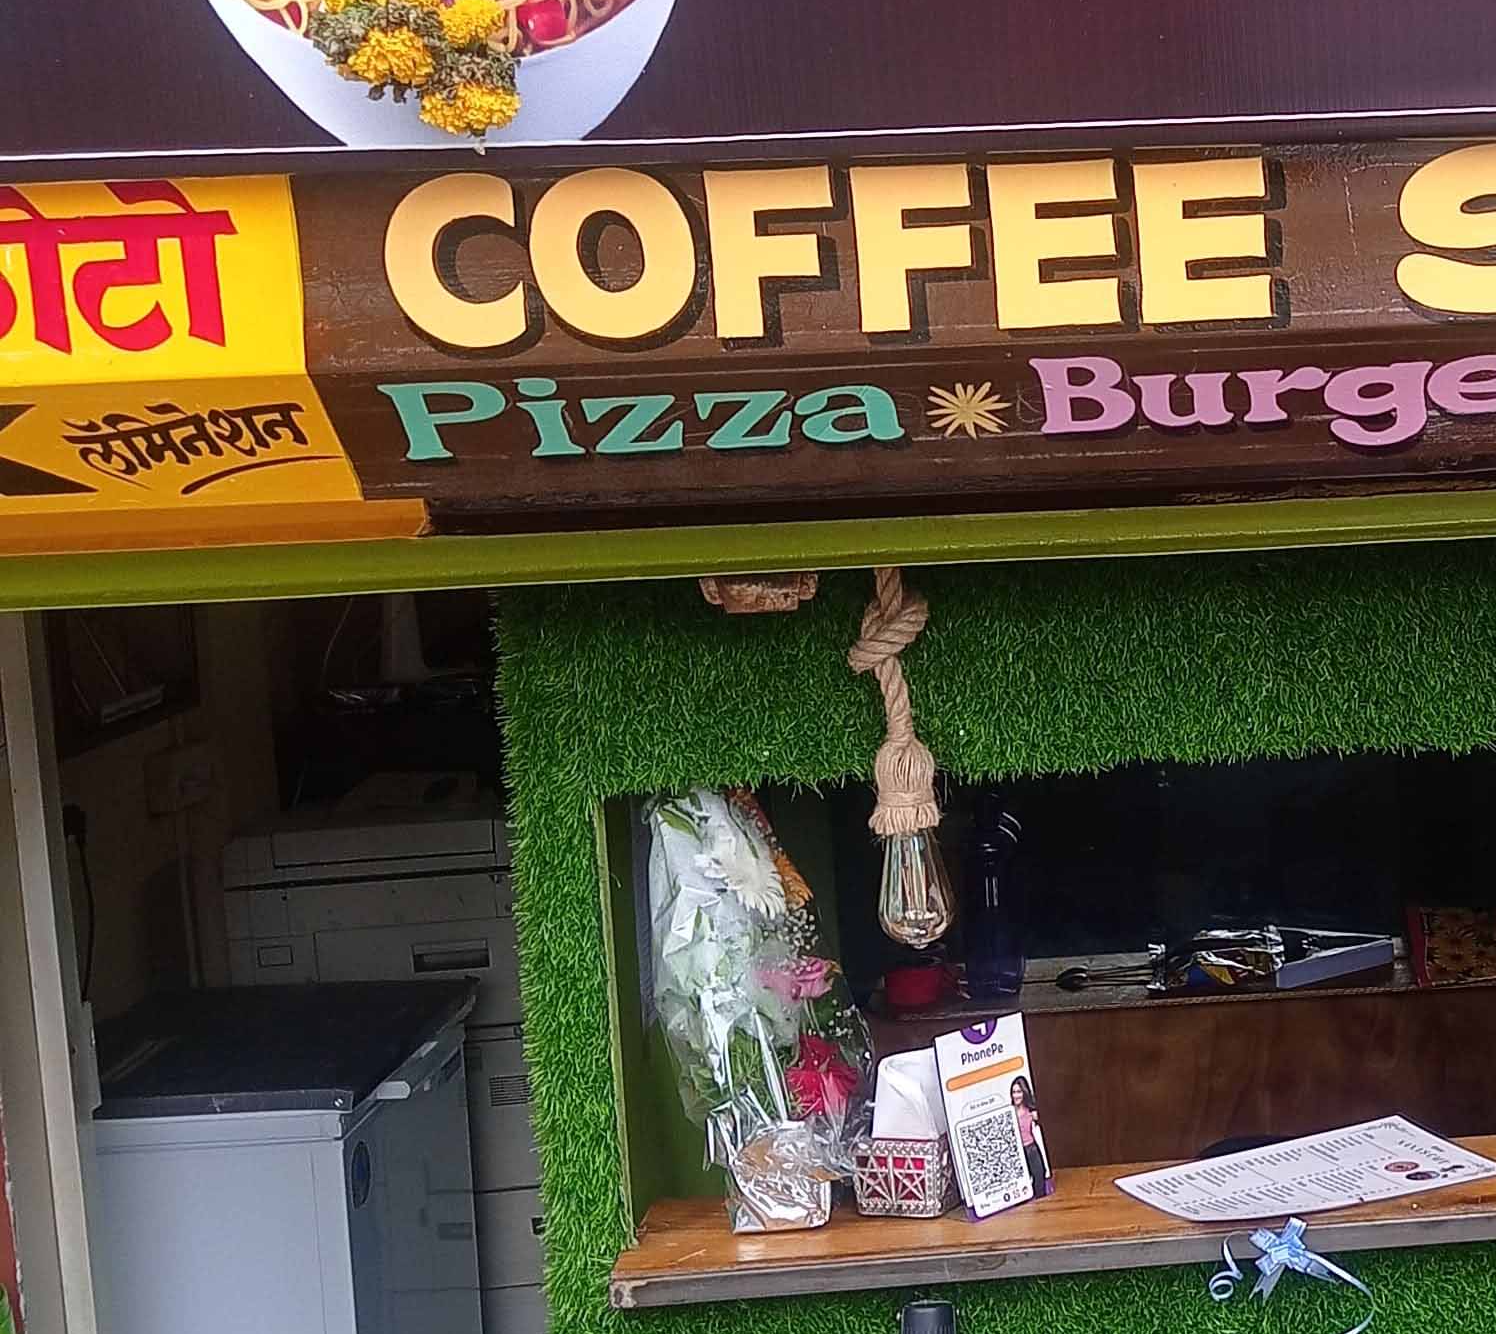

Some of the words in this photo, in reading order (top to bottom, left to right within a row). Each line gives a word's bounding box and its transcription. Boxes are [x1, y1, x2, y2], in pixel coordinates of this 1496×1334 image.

[384, 156, 1274, 349] COFFEE
[377, 378, 905, 460] Pizza
[960, 1042, 1005, 1066] PhonePe
